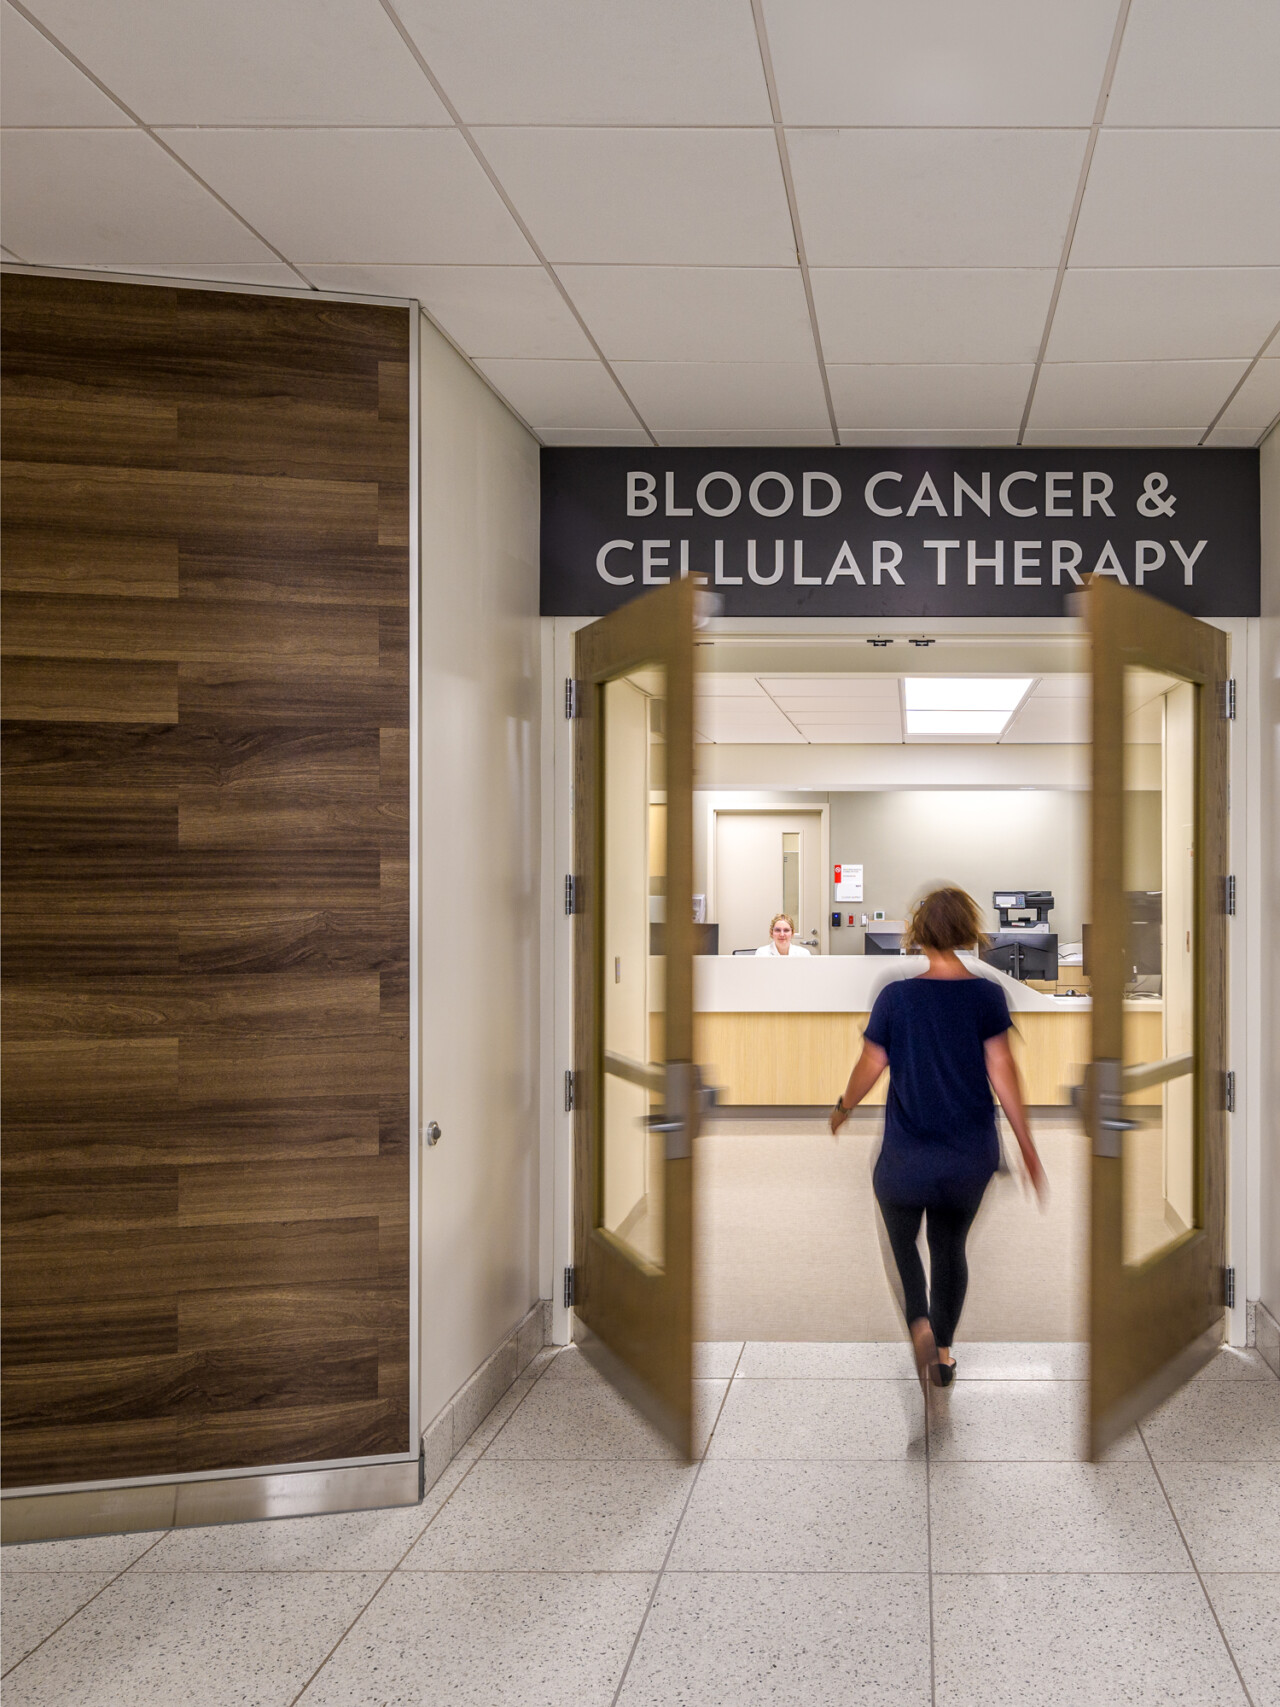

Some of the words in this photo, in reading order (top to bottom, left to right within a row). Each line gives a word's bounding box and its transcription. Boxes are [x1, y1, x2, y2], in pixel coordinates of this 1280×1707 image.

[625, 471, 842, 518] BLOOD
[864, 471, 1116, 518] CANCER
[1135, 471, 1178, 518] &
[596, 539, 905, 586] CELLULAR
[923, 539, 1209, 586] THERAPY
